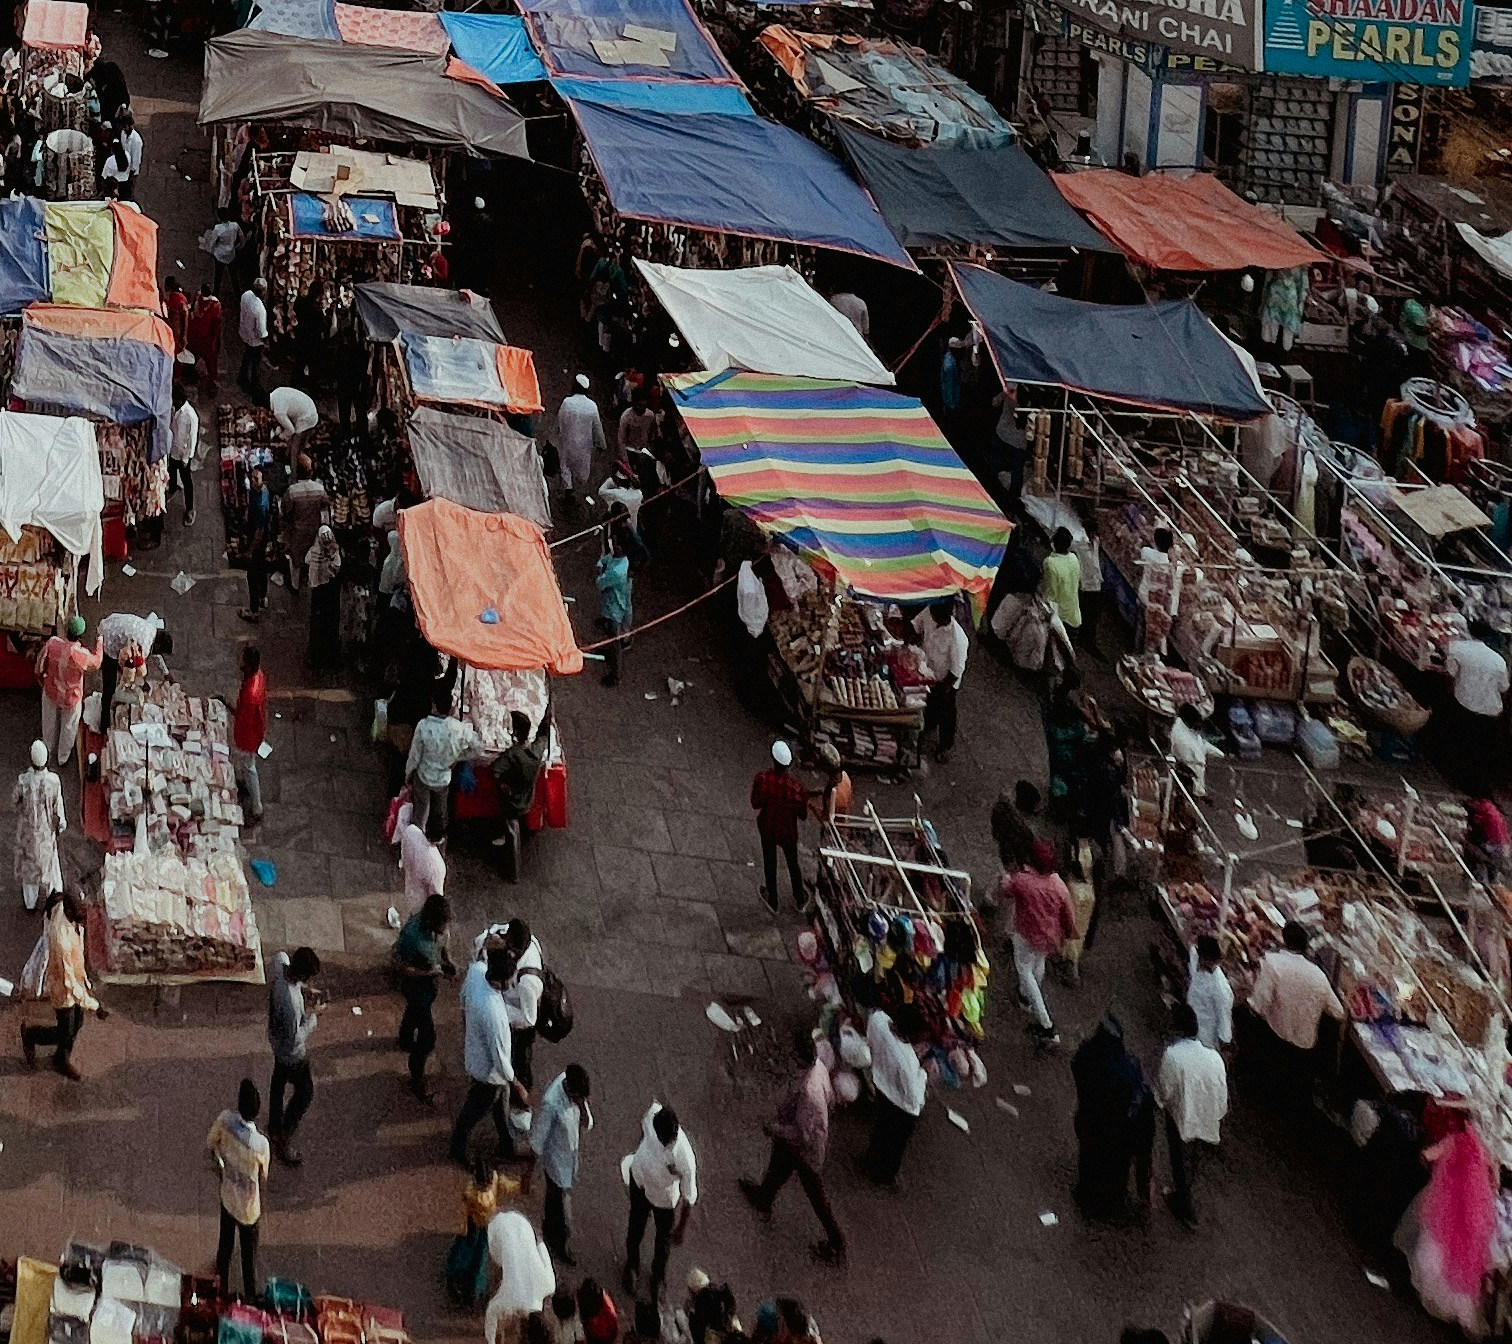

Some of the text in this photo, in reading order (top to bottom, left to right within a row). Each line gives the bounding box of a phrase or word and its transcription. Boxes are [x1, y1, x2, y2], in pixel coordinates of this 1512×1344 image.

[1070, 24, 1147, 64] PEARLS
[1158, 17, 1232, 54] CHAI
[1307, 19, 1460, 68] PEARLS
